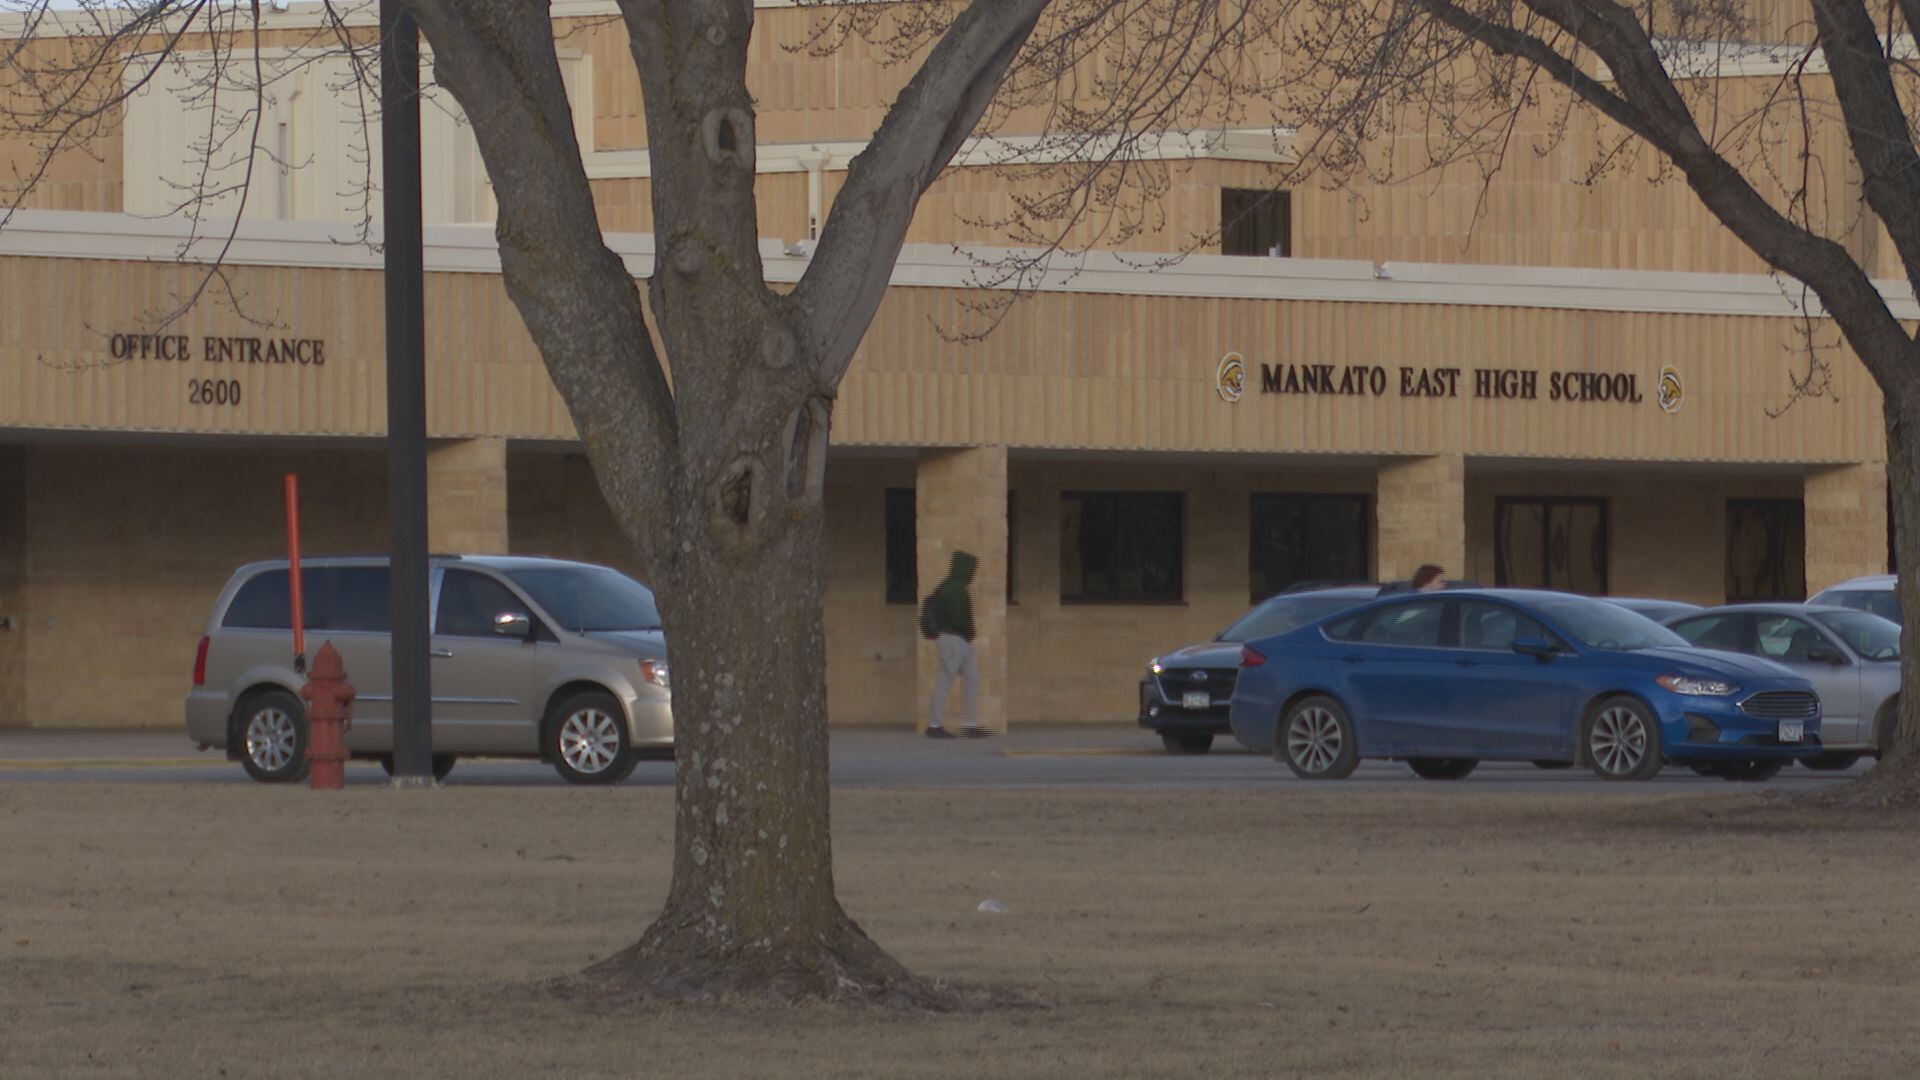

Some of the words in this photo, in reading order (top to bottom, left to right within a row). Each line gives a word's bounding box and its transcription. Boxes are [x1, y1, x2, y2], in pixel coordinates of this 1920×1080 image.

[111, 333, 190, 361] OFFICE
[203, 336, 325, 365] ENTRANCE
[188, 378, 241, 405] 2600
[1261, 363, 1386, 395] MANKATO
[1400, 366, 1460, 397] EAST
[1474, 368, 1538, 400] HIGH
[1549, 371, 1642, 403] SCHOOL
